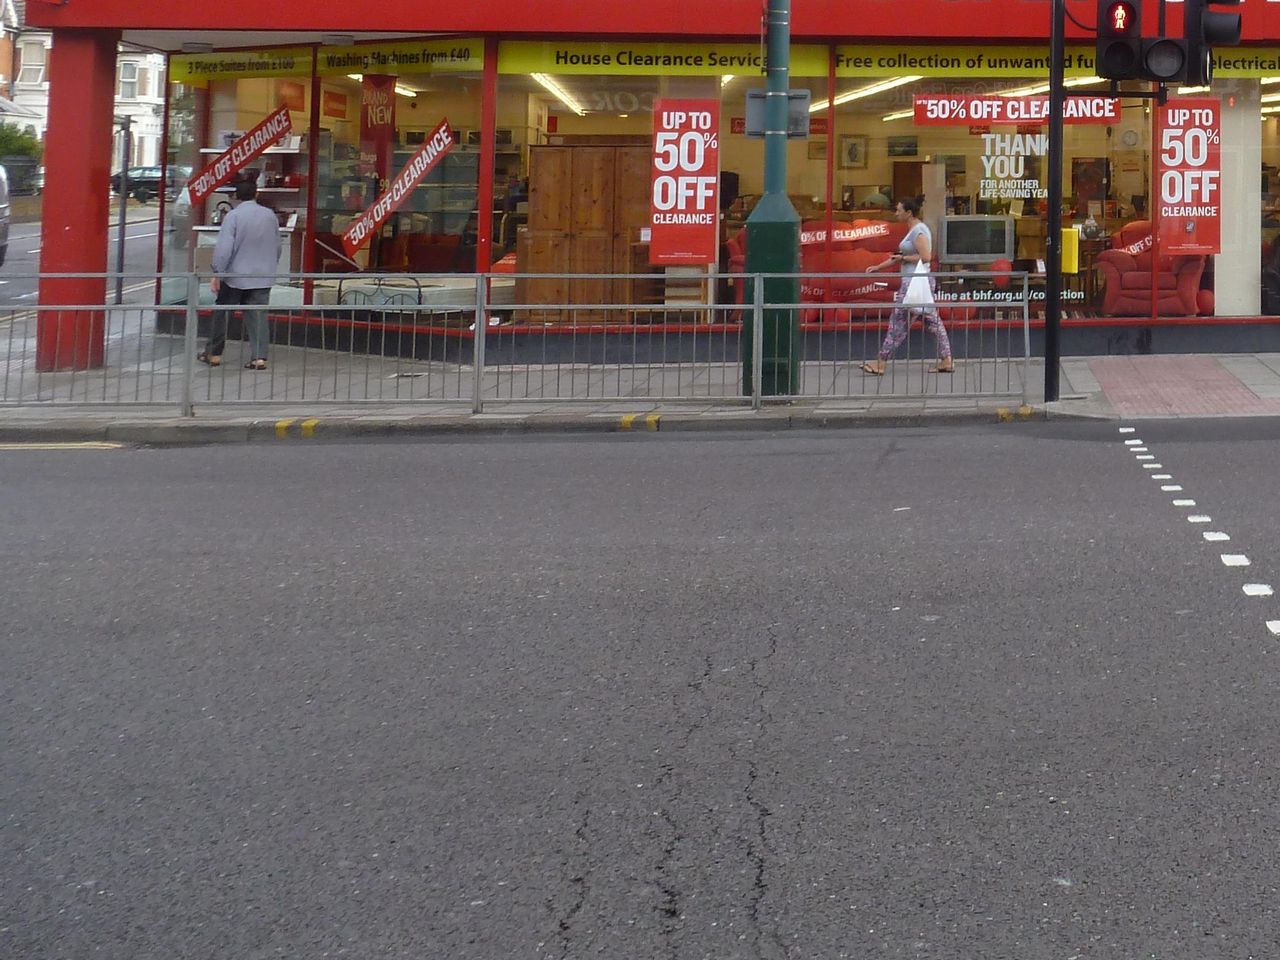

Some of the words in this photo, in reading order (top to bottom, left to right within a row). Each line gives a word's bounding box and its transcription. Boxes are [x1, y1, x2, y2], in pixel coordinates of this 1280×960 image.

[195, 61, 218, 73] Piece
[248, 59, 270, 71] from
[326, 52, 369, 69] Washing
[371, 50, 420, 65] Machines
[421, 48, 447, 63] from
[450, 47, 470, 62] £40
[555, 50, 611, 65] House
[616, 51, 702, 66] Clearance
[835, 54, 873, 67] Free
[877, 53, 961, 68] collection
[965, 54, 984, 69] of
[987, 54, 1073, 69] unwantd
[367, 106, 392, 128] NEW
[926, 99, 966, 119] 50%
[970, 99, 1001, 118] OFF
[1006, 98, 1115, 119] CLEAANCE
[1167, 108, 1190, 126] UP
[1191, 108, 1213, 126] TO
[662, 111, 686, 130] UP
[688, 111, 712, 130] TO
[194, 169, 216, 197] 50%
[214, 154, 232, 180] OFF
[231, 109, 290, 166] CLEARANCE
[654, 131, 718, 172] 50%
[1161, 127, 1220, 167] 50%
[981, 156, 1025, 179] YOU
[350, 212, 375, 246] 50%
[373, 192, 393, 222] OFF
[392, 125, 452, 202] CLEARANCE
[653, 175, 717, 211] OFF
[980, 179, 998, 189] FOR
[998, 179, 1039, 189] ANOTHER
[980, 188, 1031, 199] LIFE-SAVING
[1032, 188, 1049, 199] YEA
[1161, 170, 1220, 204] OFF
[652, 213, 713, 224] CLEARANCE
[1161, 206, 1217, 217] CLEARANCE
[800, 232, 816, 243] 0%
[833, 224, 887, 240] CLEARANCE
[959, 290, 971, 301] at
